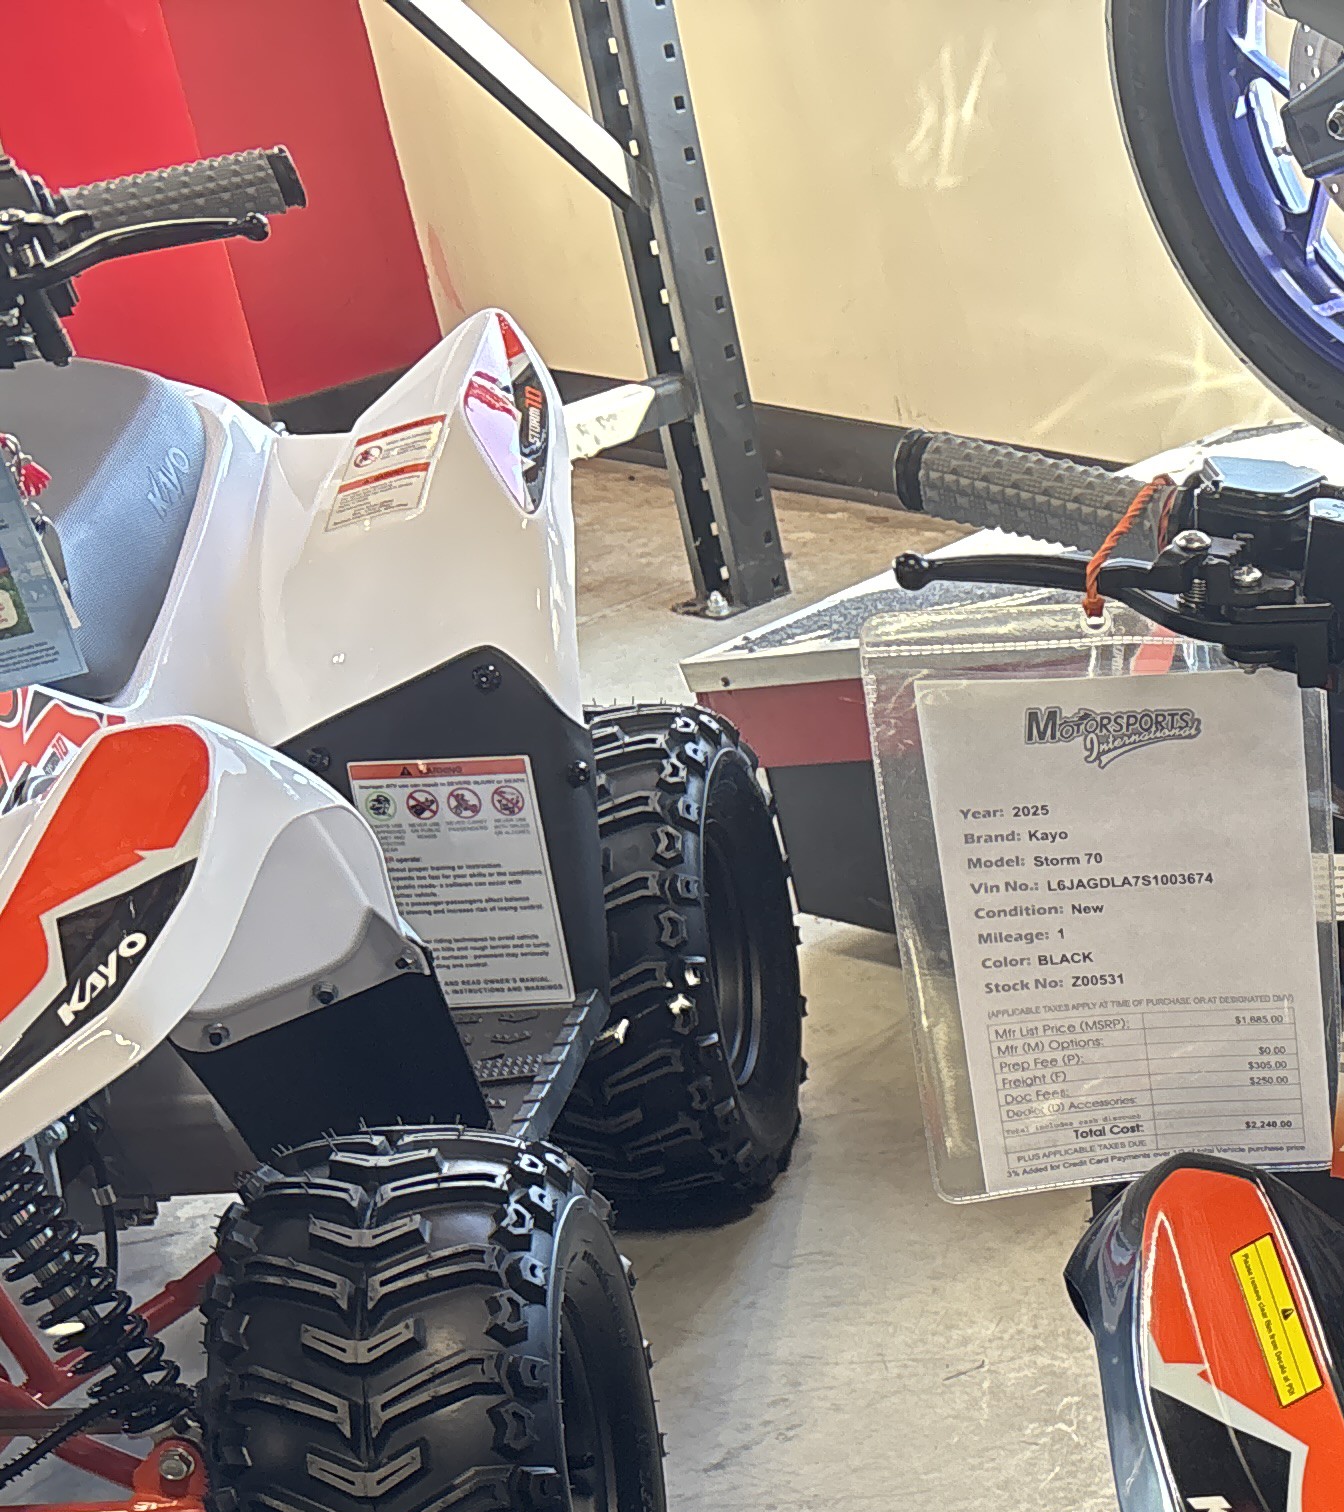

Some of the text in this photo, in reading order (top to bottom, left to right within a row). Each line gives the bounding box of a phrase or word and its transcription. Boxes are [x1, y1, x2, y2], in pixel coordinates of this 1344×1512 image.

[524, 385, 543, 409] 70
[147, 447, 191, 520] KAYO
[1026, 708, 1193, 743] MOTORSPORTS
[1084, 718, 1201, 761] International
[959, 804, 1050, 820] Year: 2025
[963, 828, 1069, 845] Brand: Kayo
[967, 852, 1103, 870] Model: Storm 70
[970, 880, 1001, 895] Vin
[1005, 879, 1040, 893] No.:
[974, 902, 1105, 920] Condition: New
[977, 928, 1066, 945] Mileage: 1
[981, 951, 1094, 970] Color: BLACK
[57, 932, 147, 1027] KAYO
[984, 973, 1125, 994] Stock No: Z00531
[1071, 1001, 1097, 1011] APPLY
[1098, 1000, 1109, 1009] AT
[1109, 999, 1131, 1008] TIME
[1132, 998, 1144, 1007] OF
[1146, 997, 1192, 1007] PURCHASE
[1207, 996, 1217, 1004] AT
[994, 1017, 1130, 1040] Mfr List Price (MSRP):
[996, 1037, 1105, 1056] Mfr (M) Options:
[1258, 1045, 1287, 1055] $0.00
[999, 1053, 1085, 1073] Prep Fee (P):
[1248, 1060, 1288, 1071] $305.00
[1001, 1070, 1067, 1089] Freight (F)
[1249, 1075, 1289, 1086] $250.00
[1004, 1092, 1033, 1105] Doc
[1068, 1095, 1138, 1111] Accessories:
[1073, 1123, 1145, 1140] Total Cost:
[1016, 1139, 1148, 1164] PLUS APPLICABLE TAXES DUE
[1006, 1169, 1020, 1179] 3%
[1021, 1165, 1049, 1176] Added
[1050, 1162, 1061, 1171] for
[1062, 1159, 1088, 1169] Credit
[1088, 1156, 1109, 1166] Card
[1110, 1152, 1151, 1164] Payments
[1247, 1145, 1285, 1154] purchase
[1286, 1144, 1306, 1153] price
[1241, 1252, 1254, 1276] Please
